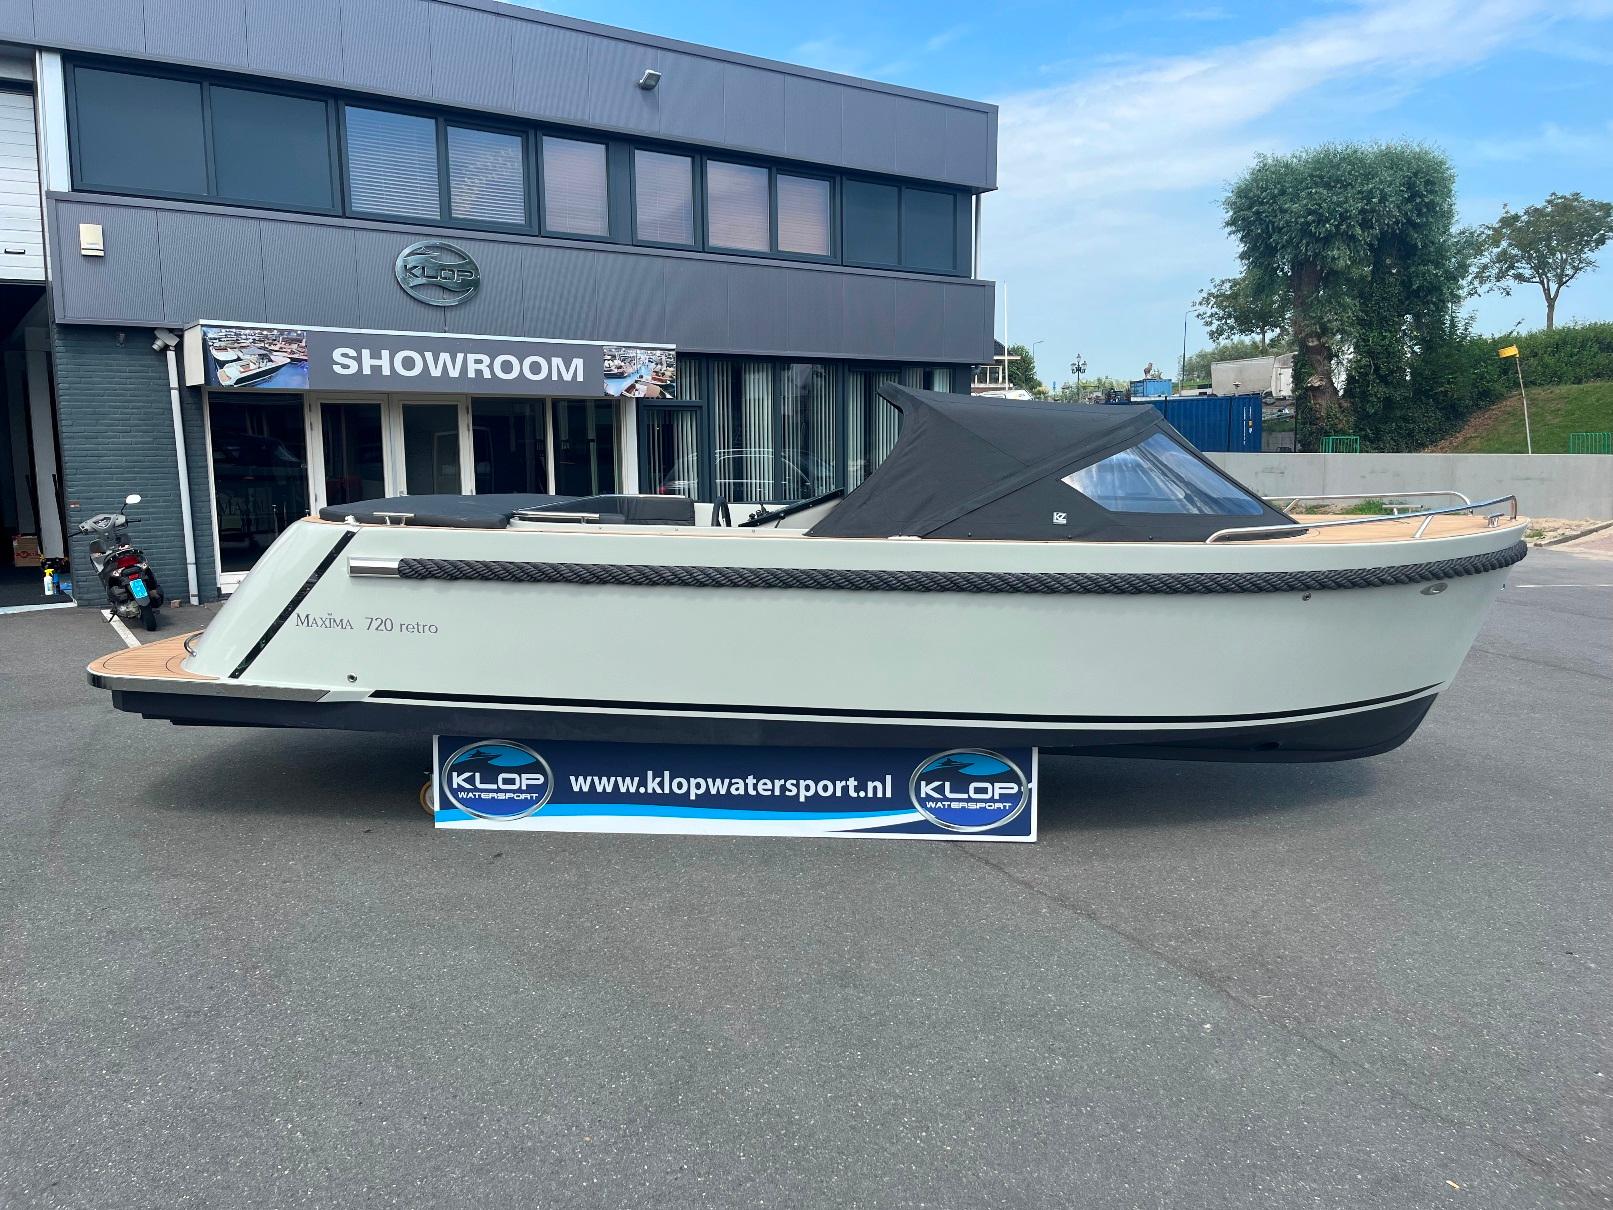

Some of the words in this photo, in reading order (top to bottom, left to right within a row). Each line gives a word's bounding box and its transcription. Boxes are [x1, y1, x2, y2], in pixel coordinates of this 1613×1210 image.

[403, 264, 475, 283] KLOP
[331, 346, 585, 382] SHOWROOM
[365, 617, 394, 632] 720
[399, 622, 439, 634] retro
[452, 771, 545, 790] KLOP
[569, 771, 892, 802] www.klopwatersport.nl
[920, 780, 1019, 799] KLOP
[458, 791, 539, 800] WATERSPORT
[925, 801, 1013, 810] WATERSPORT
